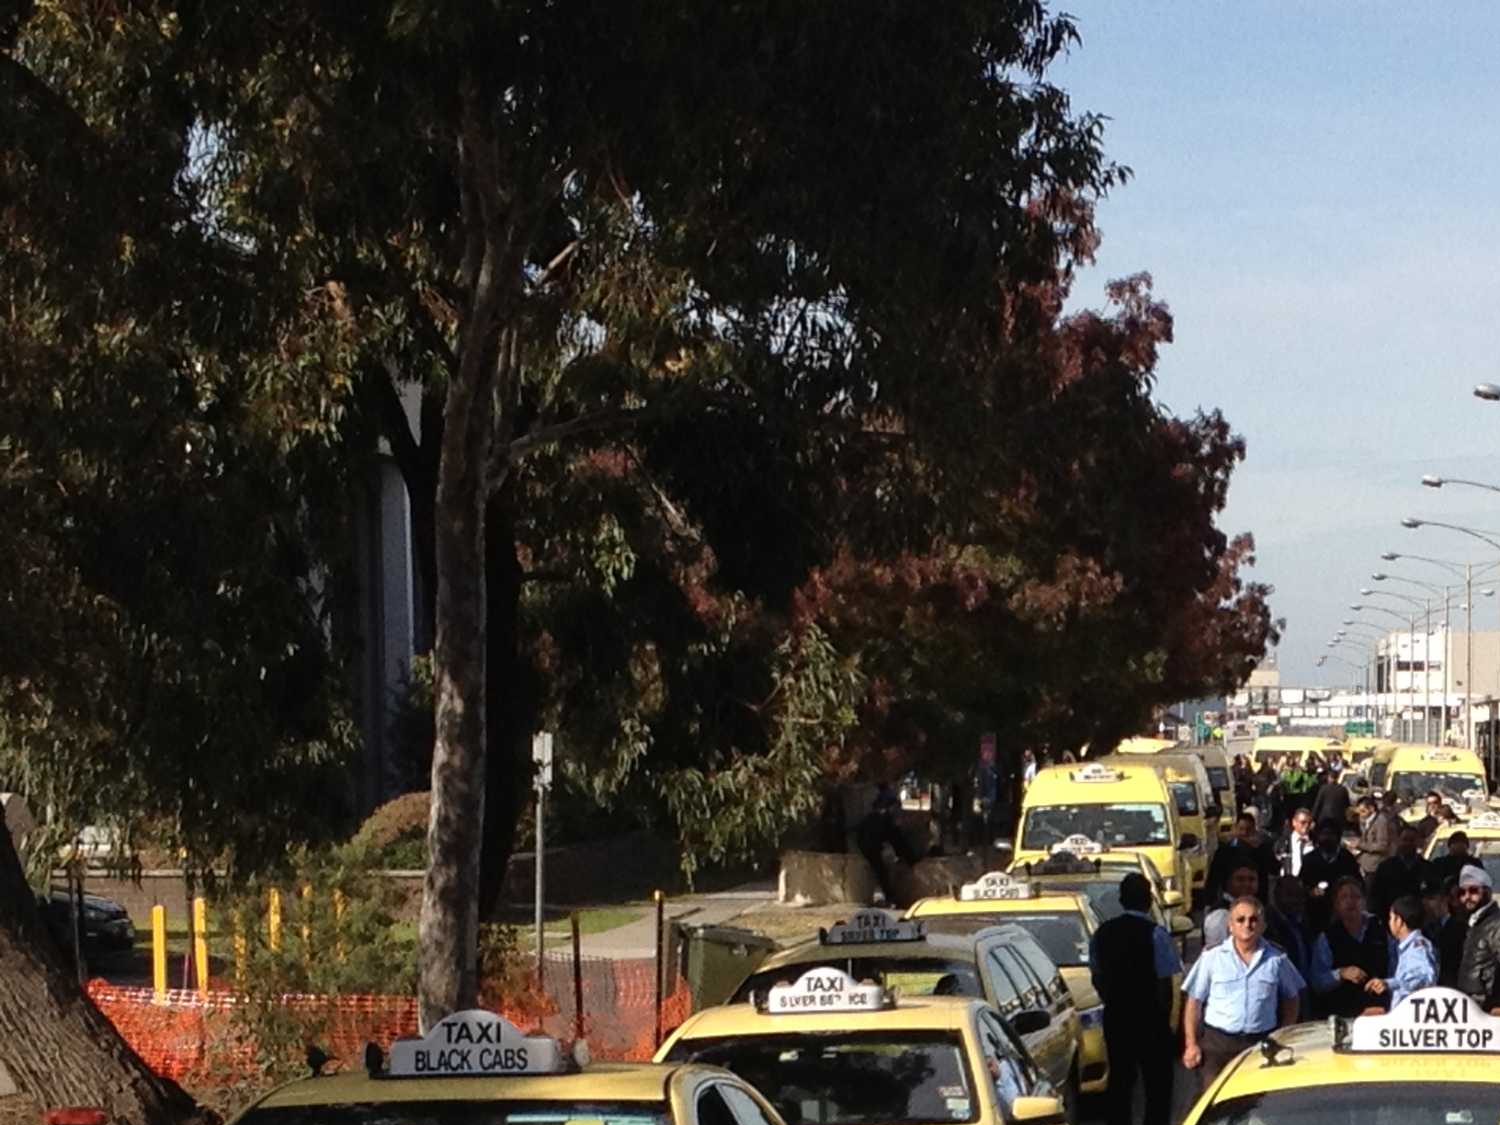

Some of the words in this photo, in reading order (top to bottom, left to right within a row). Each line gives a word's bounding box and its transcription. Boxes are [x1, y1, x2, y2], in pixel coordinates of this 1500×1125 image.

[984, 877, 1010, 888] TAXI
[856, 914, 886, 928] TAXI
[805, 976, 844, 993] TAXI
[780, 994, 817, 1008] SLVER
[1410, 997, 1469, 1024] TAXI
[441, 1021, 503, 1045] TAXI
[1378, 1028, 1449, 1048] SILVER
[1454, 1028, 1494, 1049] TOP
[414, 1049, 472, 1073] BLACK
[478, 1047, 529, 1071] CABS
